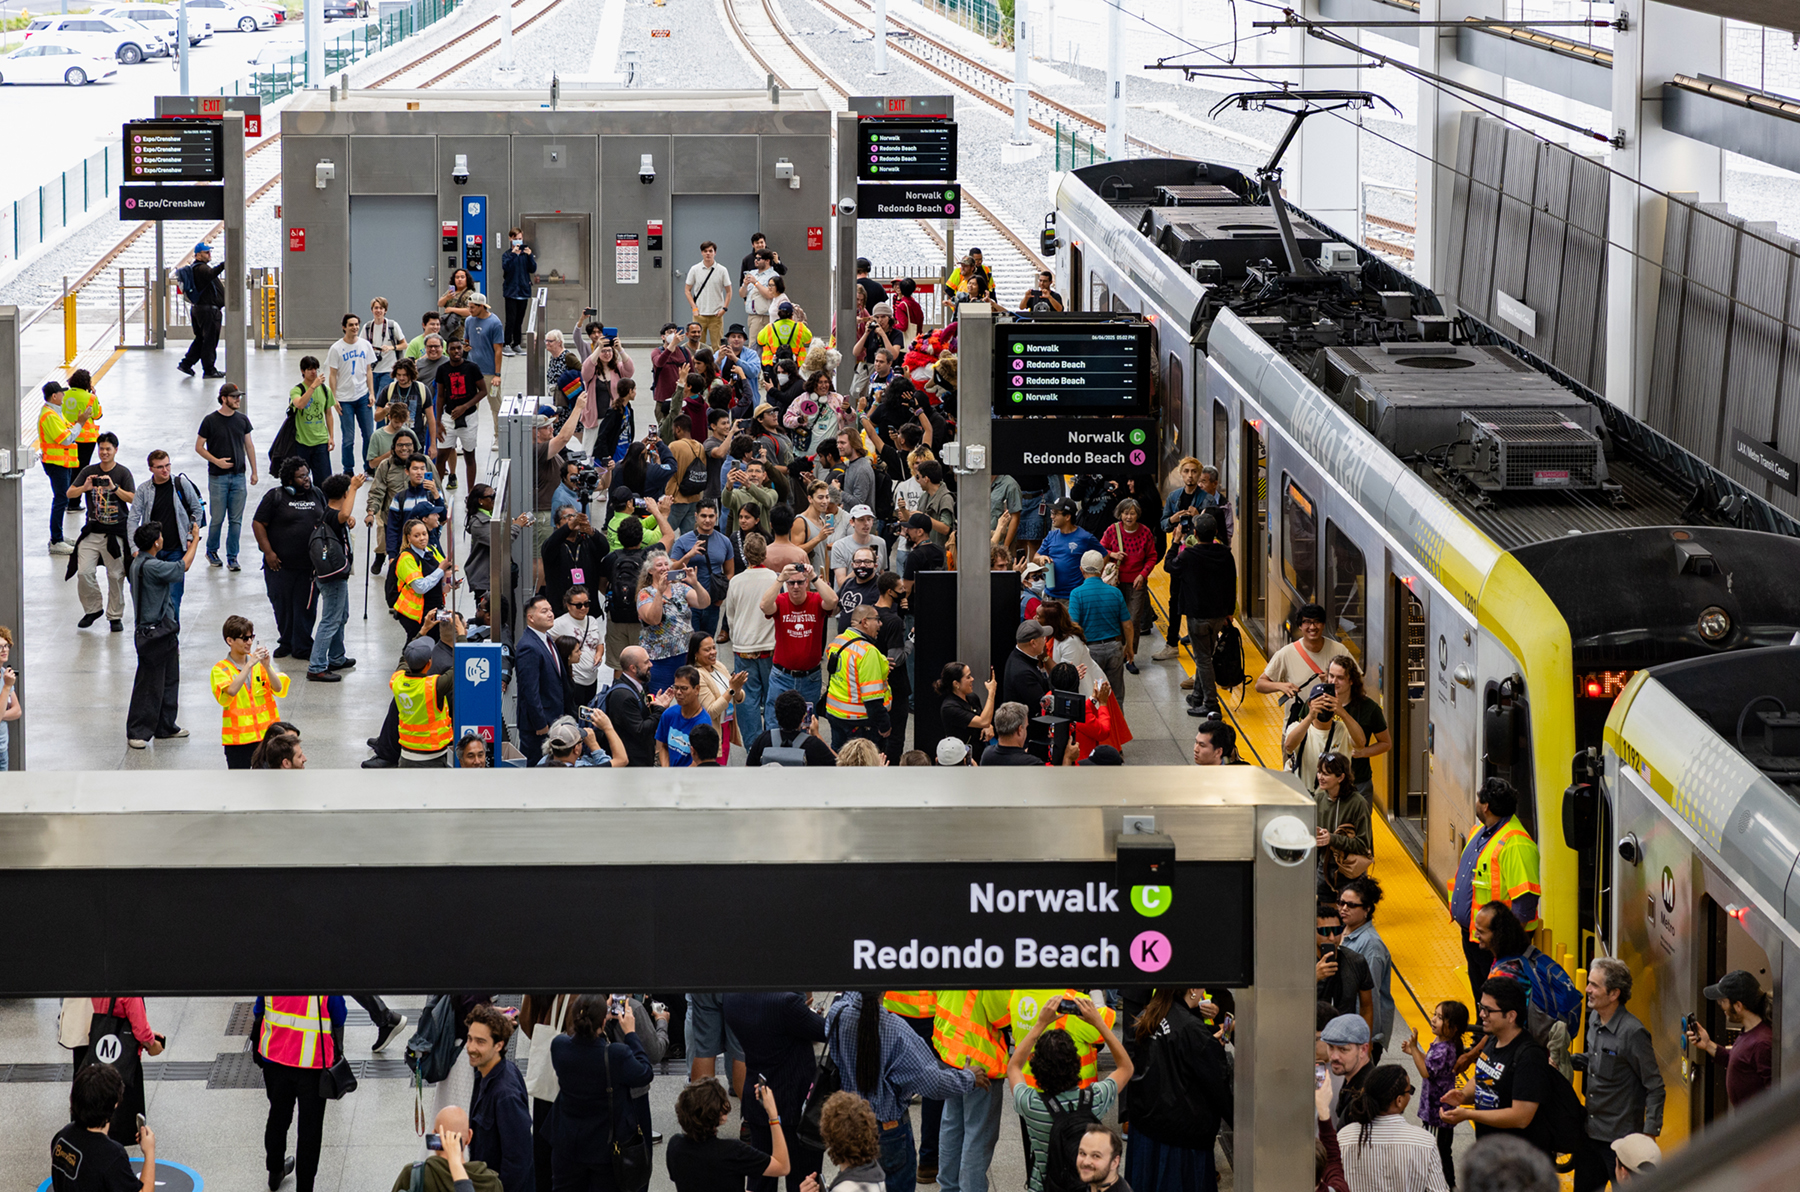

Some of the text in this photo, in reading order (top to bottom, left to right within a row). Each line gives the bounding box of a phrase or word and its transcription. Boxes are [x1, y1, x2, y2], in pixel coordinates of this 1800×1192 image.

[203, 100, 220, 112] EXIT
[888, 99, 906, 111] EXIT
[905, 191, 942, 200] Norwalk
[138, 199, 206, 209] Expo/Crenshaw
[878, 204, 914, 212] Redondo
[916, 204, 942, 212] Beach
[1026, 344, 1059, 352] Norwalk
[342, 350, 366, 362] UCLA
[1026, 360, 1060, 368] Redondo
[1061, 360, 1086, 368] Beach
[1026, 393, 1058, 401] Norwalk
[1068, 431, 1125, 443] Norwalk
[1290, 384, 1379, 504] Metro Rail
[1023, 452, 1081, 464] Redondo
[1084, 452, 1125, 464] Beach
[1760, 454, 1774, 472] Transit
[1775, 462, 1790, 480] Center
[1464, 590, 1477, 618] 1201
[1623, 740, 1640, 773] 1192
[970, 882, 1120, 913] Norwalk
[1661, 911, 1675, 936] Metro
[853, 938, 1004, 969] Redondo
[1015, 938, 1120, 968] Beach
